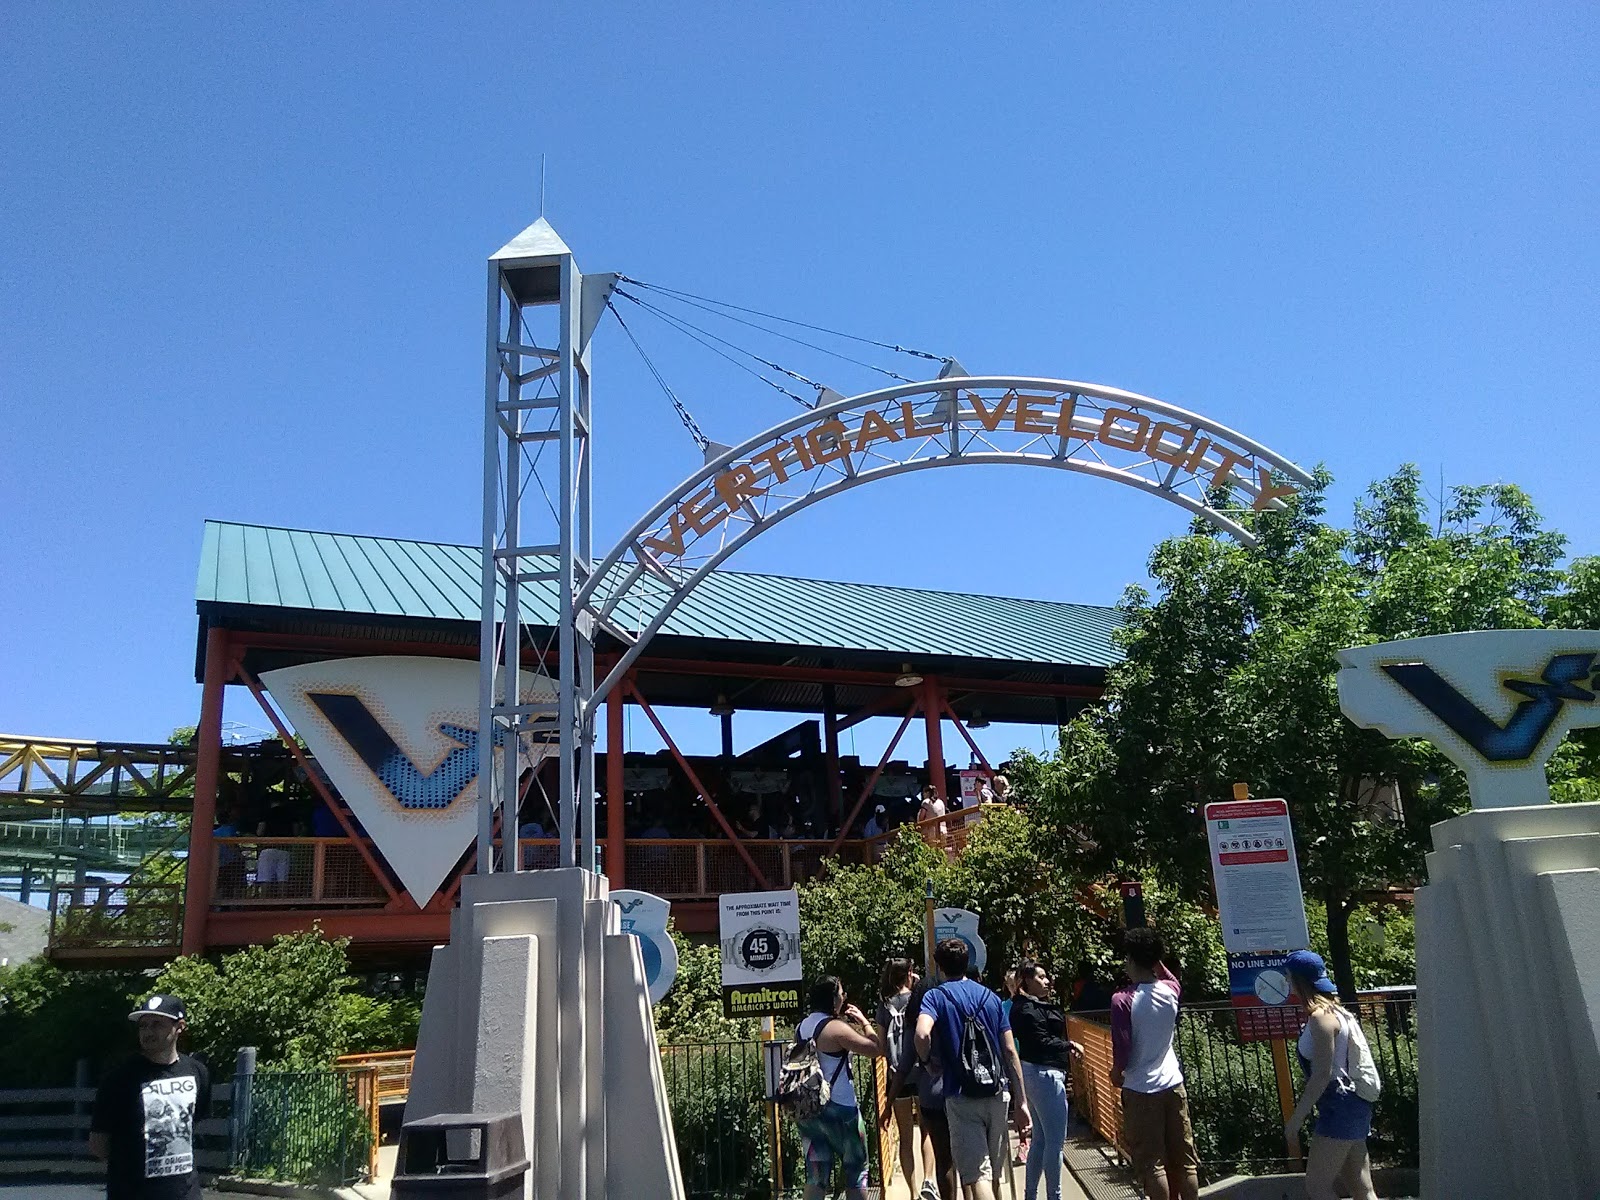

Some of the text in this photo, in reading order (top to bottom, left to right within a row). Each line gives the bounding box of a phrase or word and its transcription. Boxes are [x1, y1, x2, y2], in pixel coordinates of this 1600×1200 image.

[645, 394, 1298, 556] VERTICAL VELOCITY
[750, 938, 768, 953] 45
[750, 953, 774, 961] MINUTES
[1231, 958, 1287, 969] NO LINE JUM
[731, 987, 798, 1005] Armitron
[732, 1001, 798, 1012] AMERICA'S WATCH
